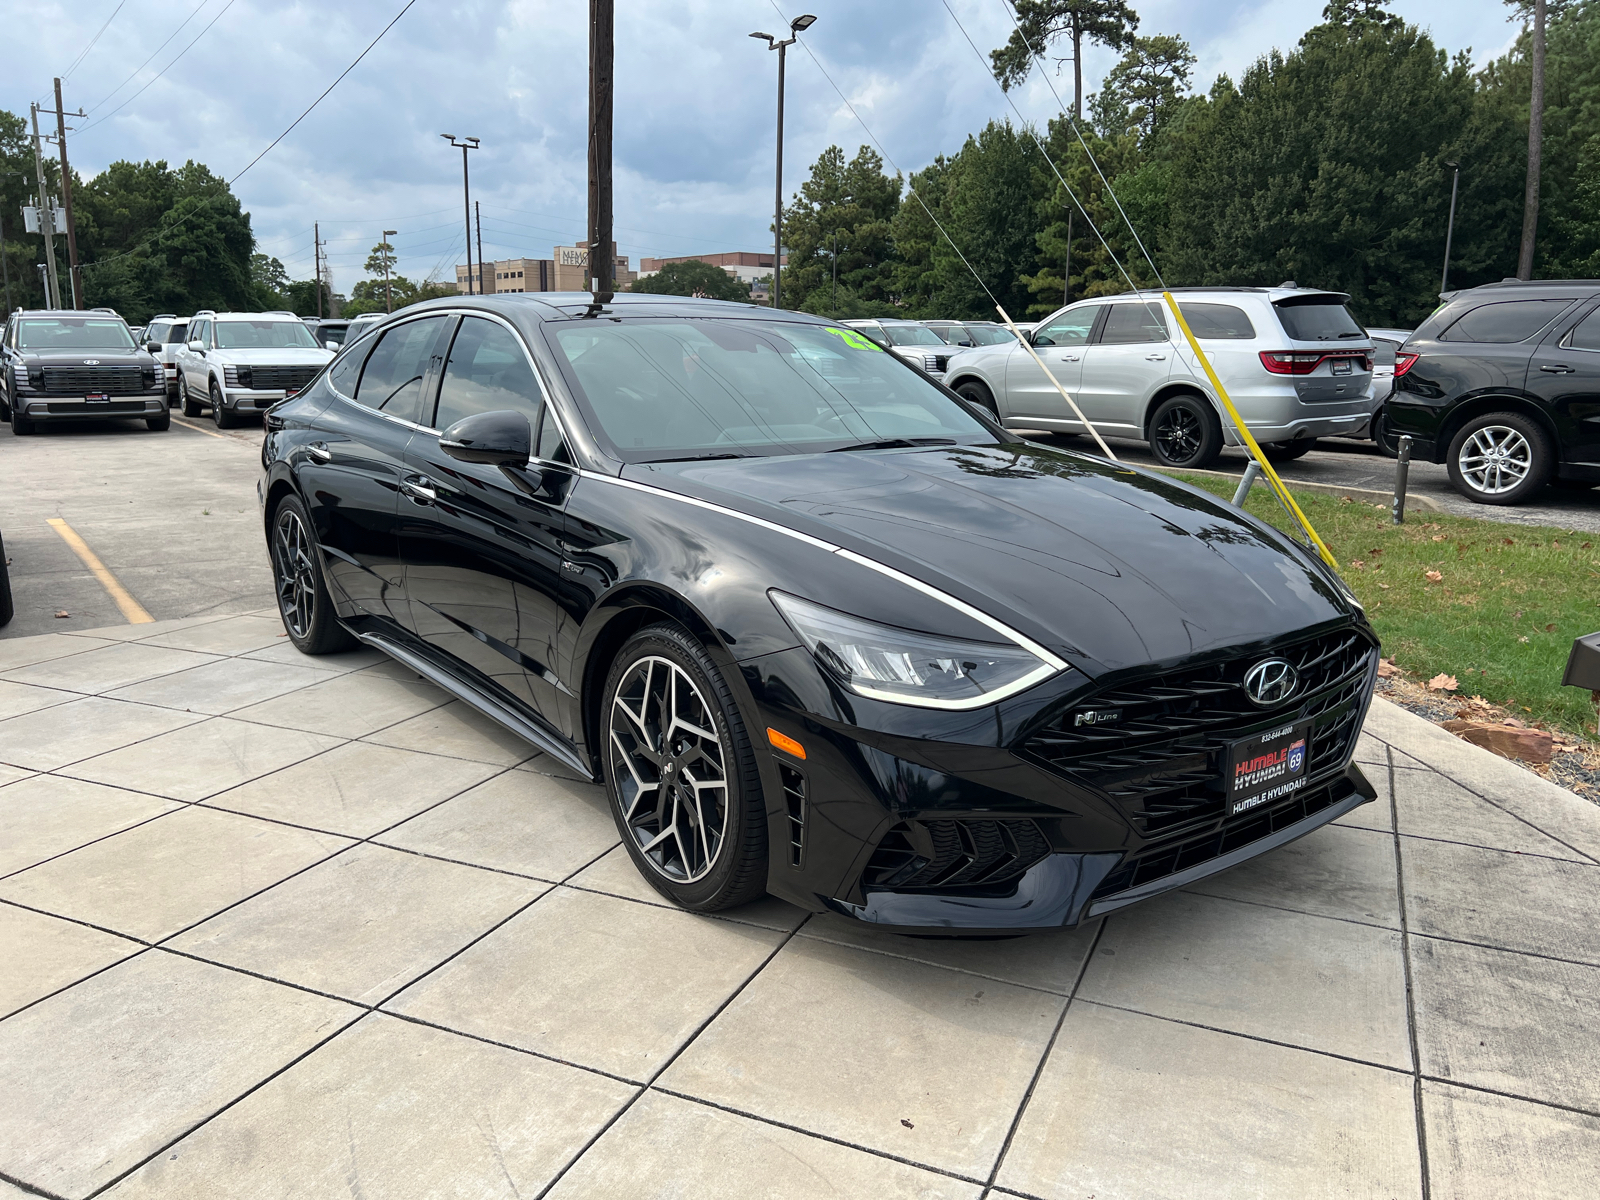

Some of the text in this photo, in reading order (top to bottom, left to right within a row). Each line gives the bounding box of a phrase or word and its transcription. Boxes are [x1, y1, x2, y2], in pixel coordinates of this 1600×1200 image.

[1235, 748, 1288, 776] HUMBLE
[1290, 752, 1302, 768] 69
[1234, 762, 1286, 790] HYUNDAI
[1233, 779, 1302, 814] HUMBLE HYUNDAI
